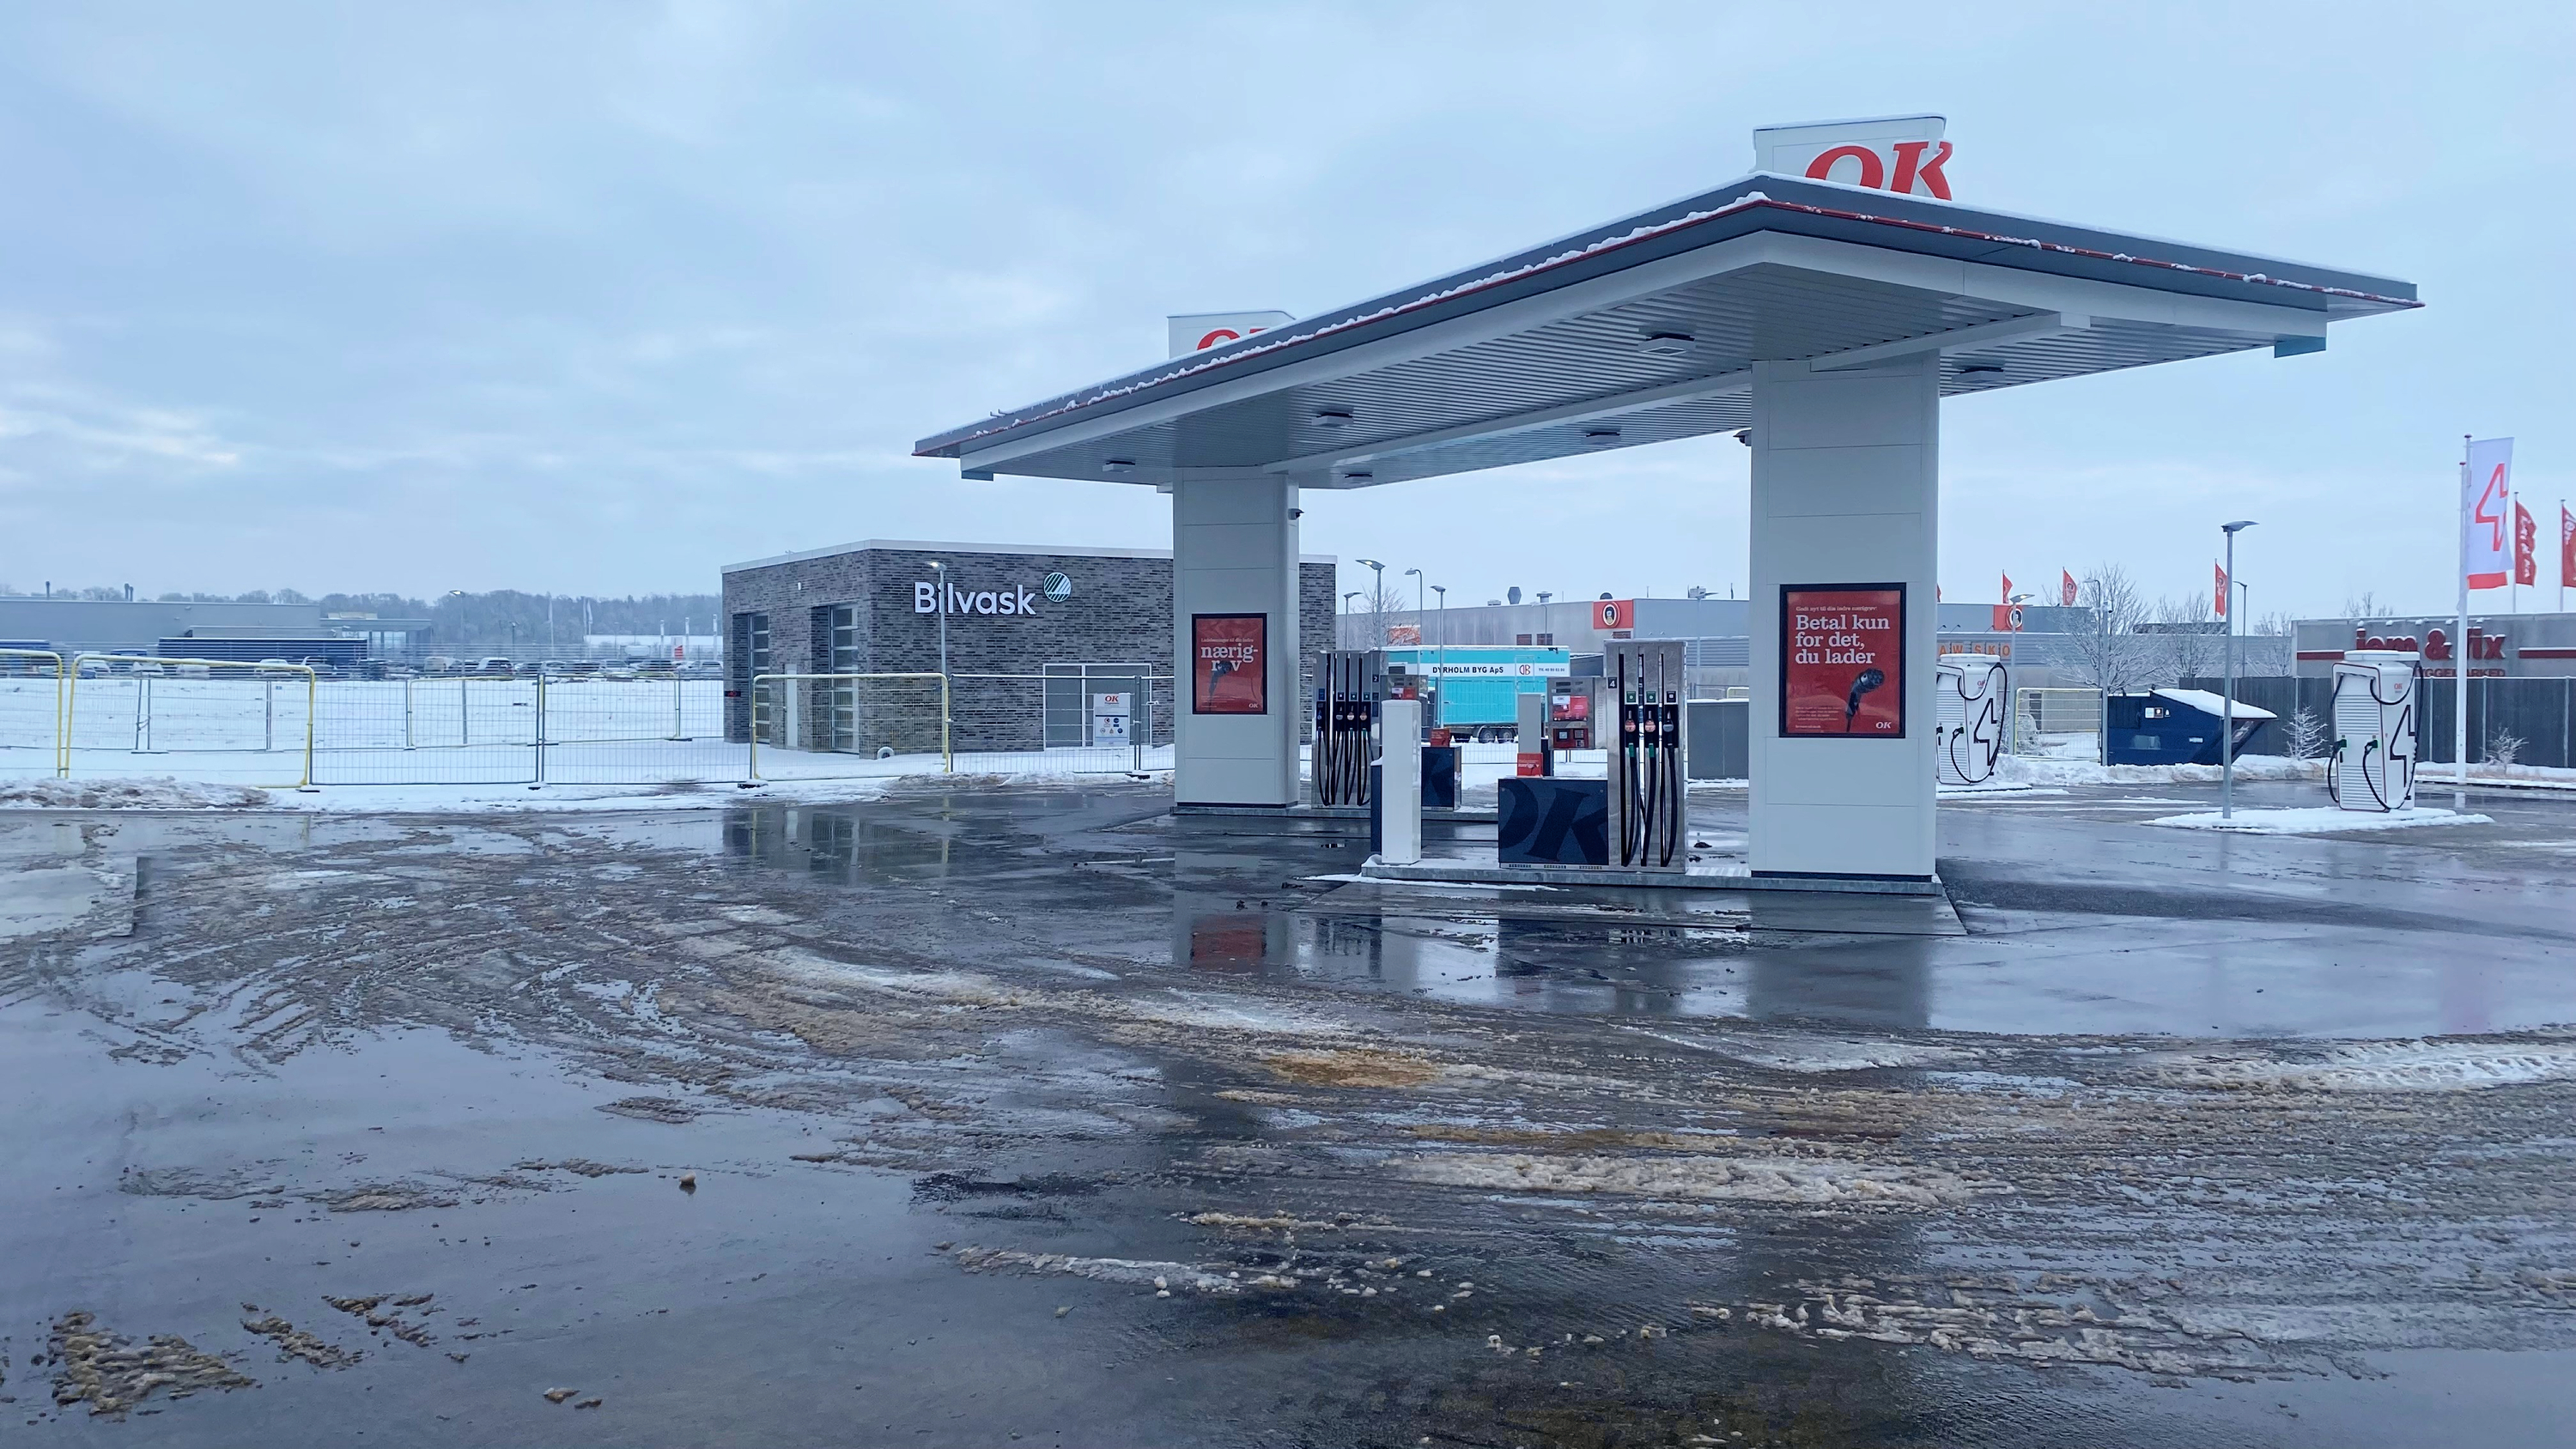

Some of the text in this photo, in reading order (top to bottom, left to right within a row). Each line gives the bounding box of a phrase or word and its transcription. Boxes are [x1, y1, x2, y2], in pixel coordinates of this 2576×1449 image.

[1805, 141, 1953, 201] OK
[914, 581, 1037, 615] Bilvask
[1795, 614, 1891, 630] Betal kun
[1795, 631, 1865, 650] for det,
[2425, 627, 2453, 660] &
[1200, 643, 1259, 663] nærig-
[1795, 648, 1876, 664] du lader
[1212, 660, 1242, 671] rv
[1489, 666, 1504, 675] ApS
